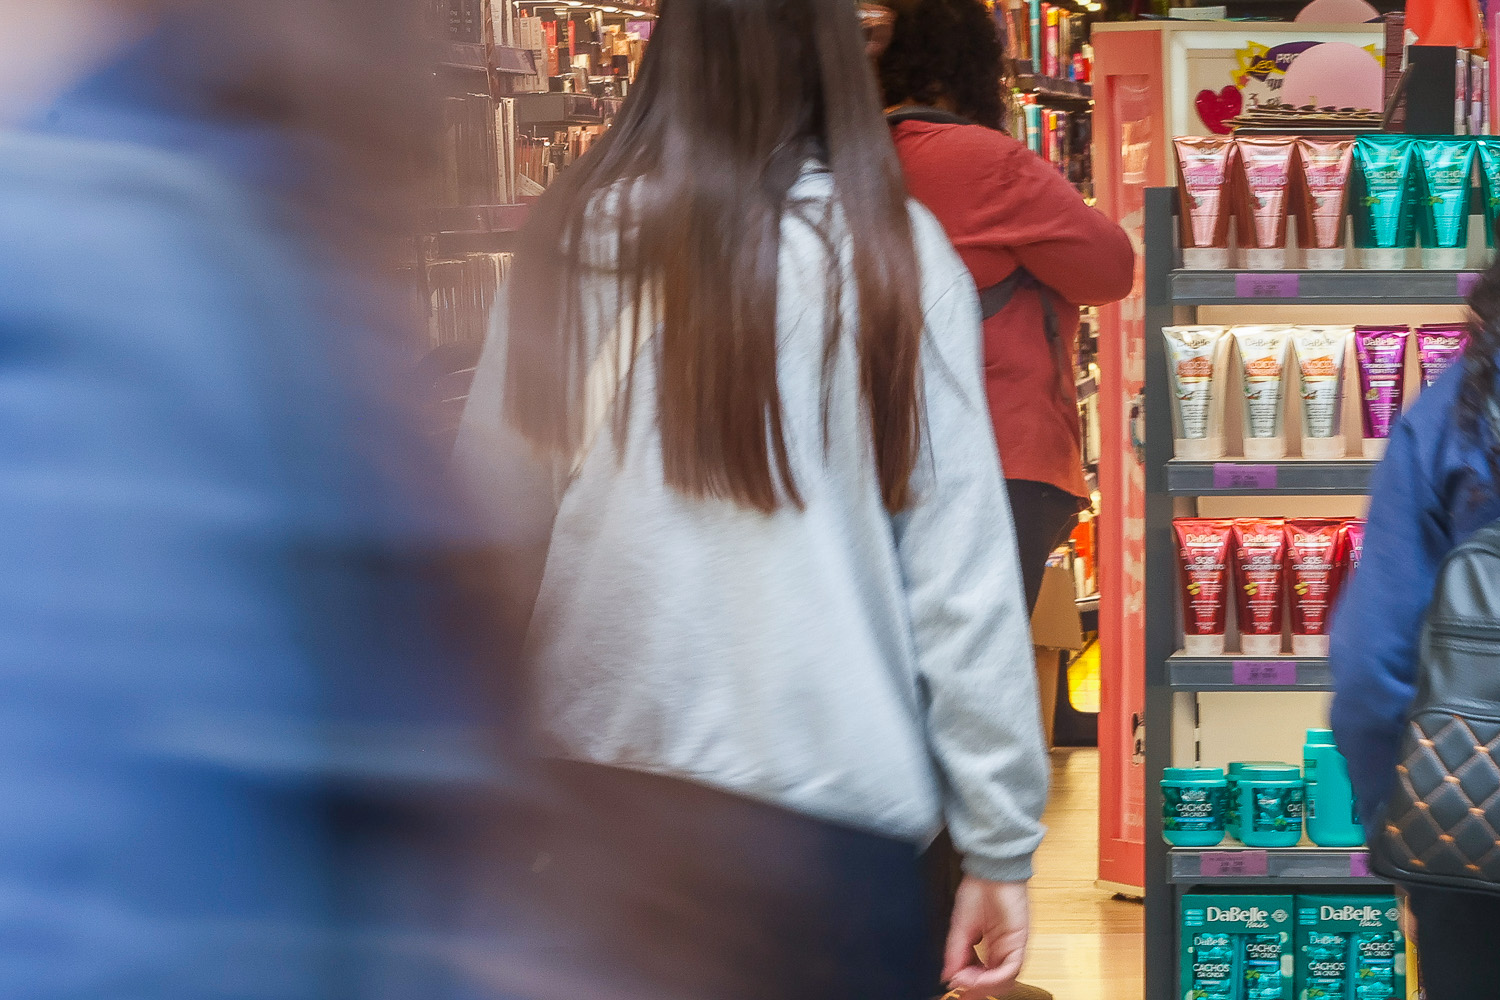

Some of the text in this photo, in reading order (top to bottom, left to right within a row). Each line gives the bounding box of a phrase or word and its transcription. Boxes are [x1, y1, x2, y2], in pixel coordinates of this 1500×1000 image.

[1176, 803, 1213, 812] CACHOS
[1206, 906, 1269, 923] DaBelle
[1320, 905, 1383, 922] DaBelle
[1246, 943, 1282, 953] CACHOS
[1358, 942, 1396, 952] CACHOS
[1193, 963, 1230, 973] CACHOS
[1308, 962, 1346, 971] CACHOS
